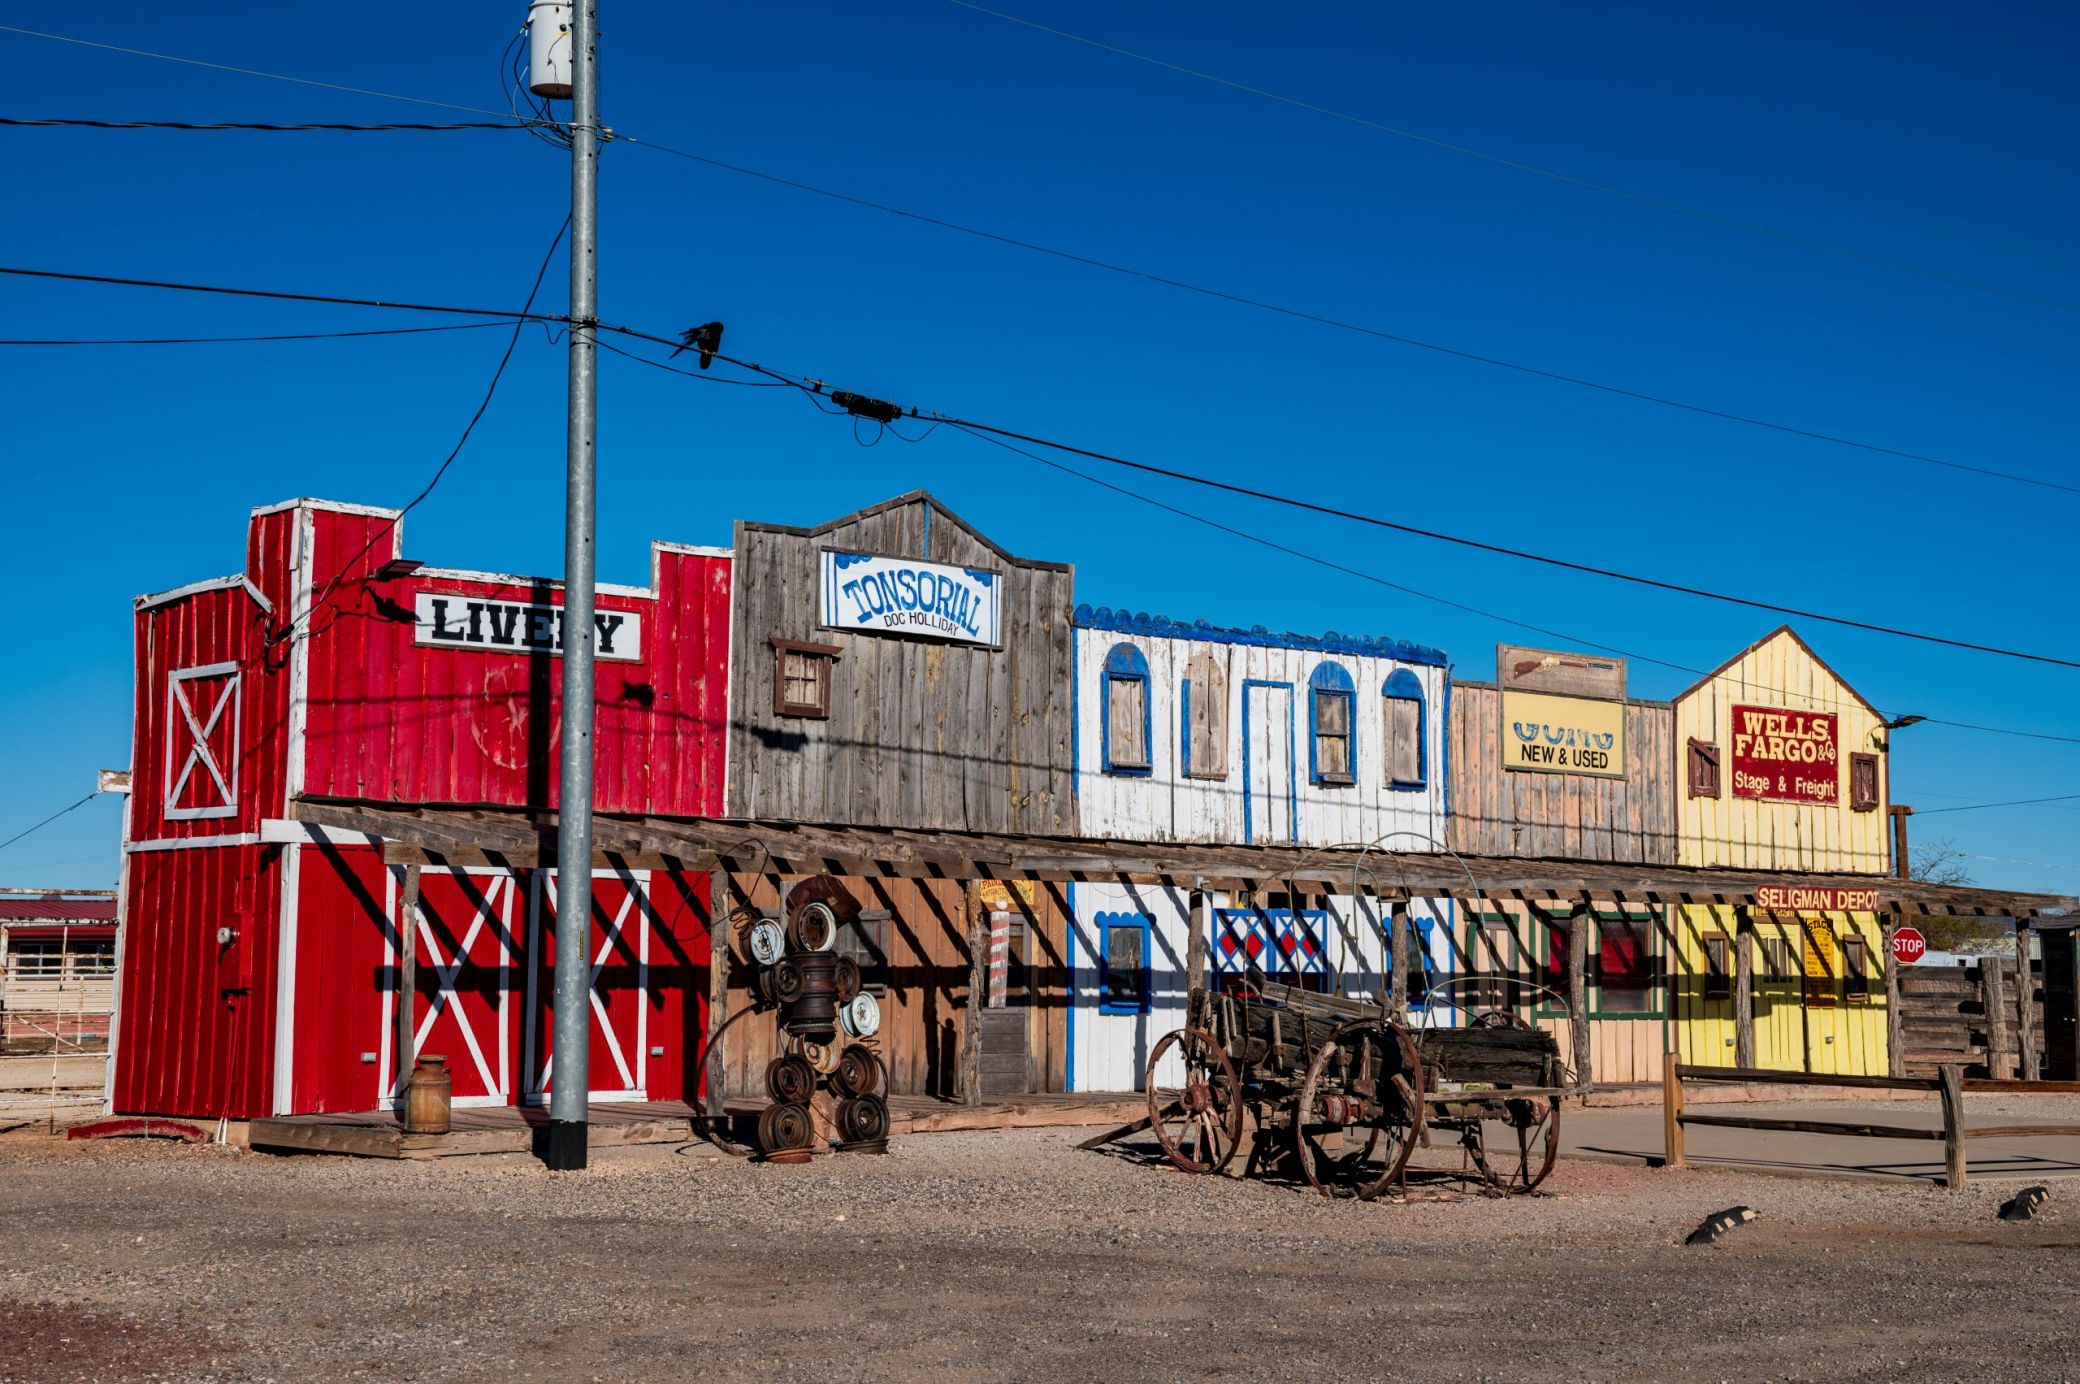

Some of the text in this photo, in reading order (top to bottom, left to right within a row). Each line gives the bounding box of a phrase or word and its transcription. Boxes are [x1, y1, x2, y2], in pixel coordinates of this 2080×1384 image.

[842, 569, 981, 637] TONSORIAL
[431, 598, 623, 654] LIVEY
[884, 612, 960, 637] DOC HOLLIDAY
[1521, 744, 1609, 769] NEW & USED
[1735, 733, 1817, 764] FARGO
[1818, 744, 1826, 762] &
[1735, 770, 1835, 800] Stage & Freight
[1758, 887, 1879, 910] SELIGMAN DEPOT
[1893, 938, 1923, 953] STOP
